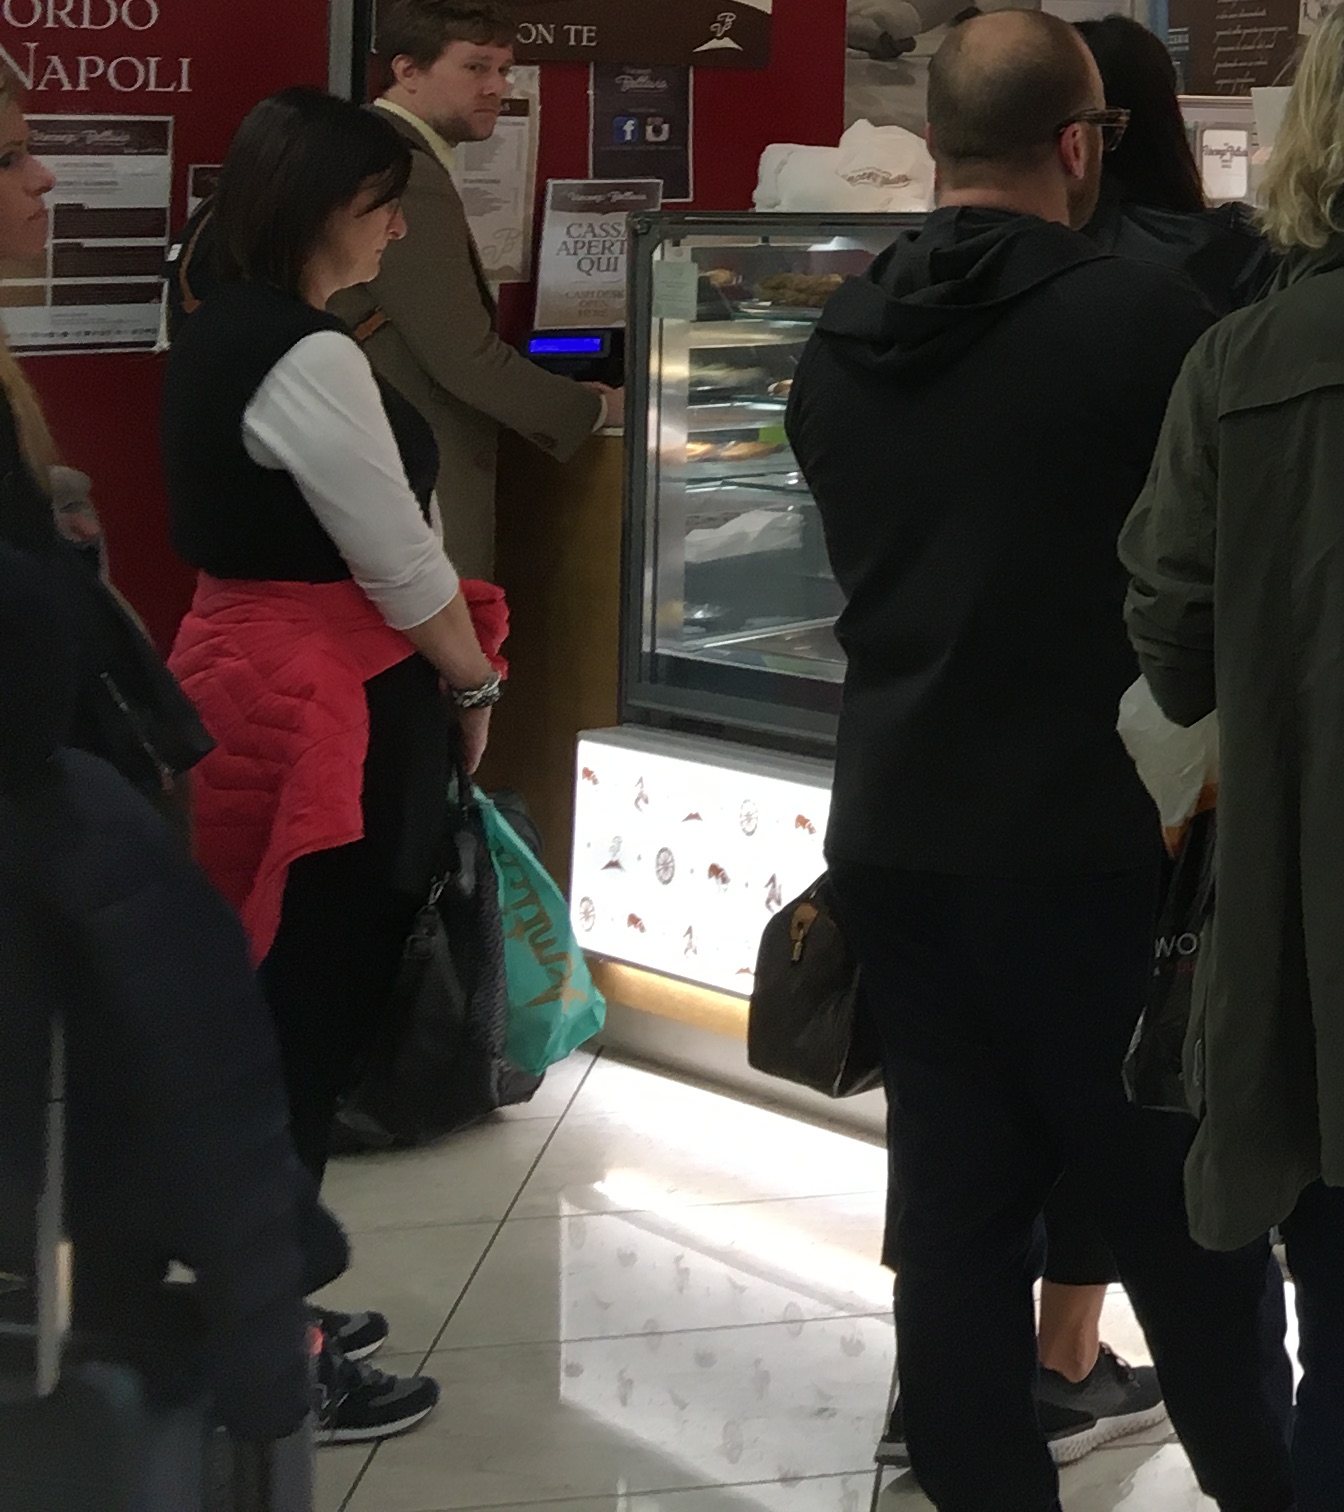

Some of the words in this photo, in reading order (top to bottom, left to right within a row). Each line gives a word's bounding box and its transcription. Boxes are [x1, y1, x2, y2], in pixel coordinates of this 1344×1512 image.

[517, 23, 555, 45] ON
[563, 24, 598, 46] TE
[0, 42, 192, 92] NAPOLI
[556, 239, 627, 256] APERT
[576, 256, 619, 276] QUI
